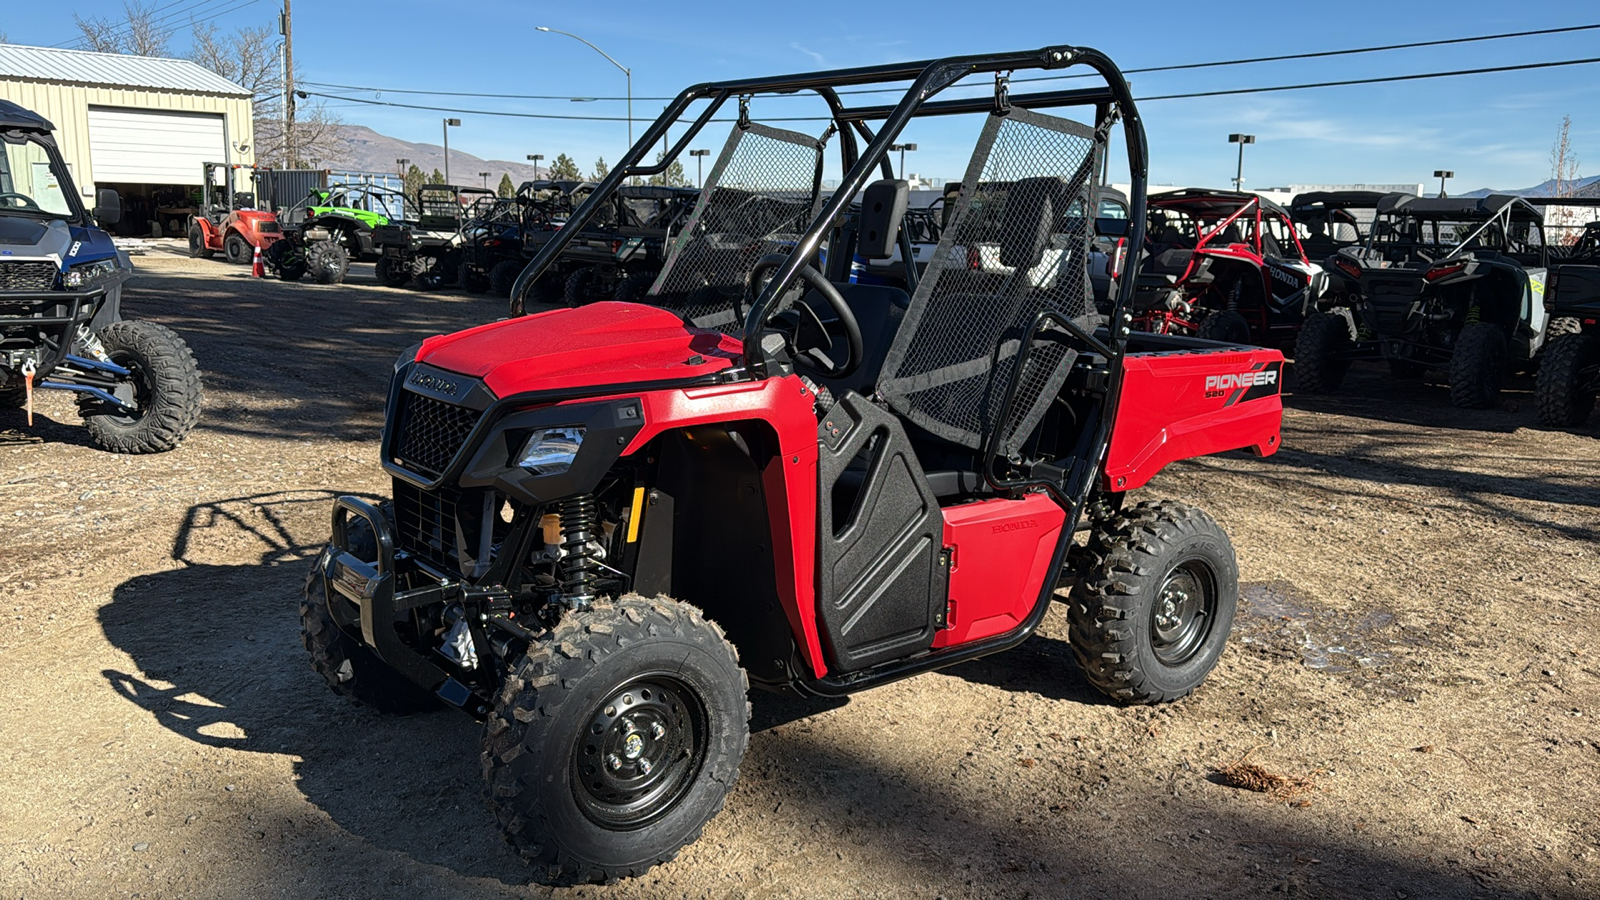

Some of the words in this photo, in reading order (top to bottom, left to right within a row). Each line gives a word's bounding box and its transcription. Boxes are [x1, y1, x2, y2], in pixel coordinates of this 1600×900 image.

[68, 240, 82, 257] 1000
[1269, 265, 1299, 289] HONDA
[410, 372, 458, 396] HONDA
[1205, 370, 1277, 391] PIONEER
[1205, 390, 1225, 398] 520
[991, 519, 1039, 535] HONDA
